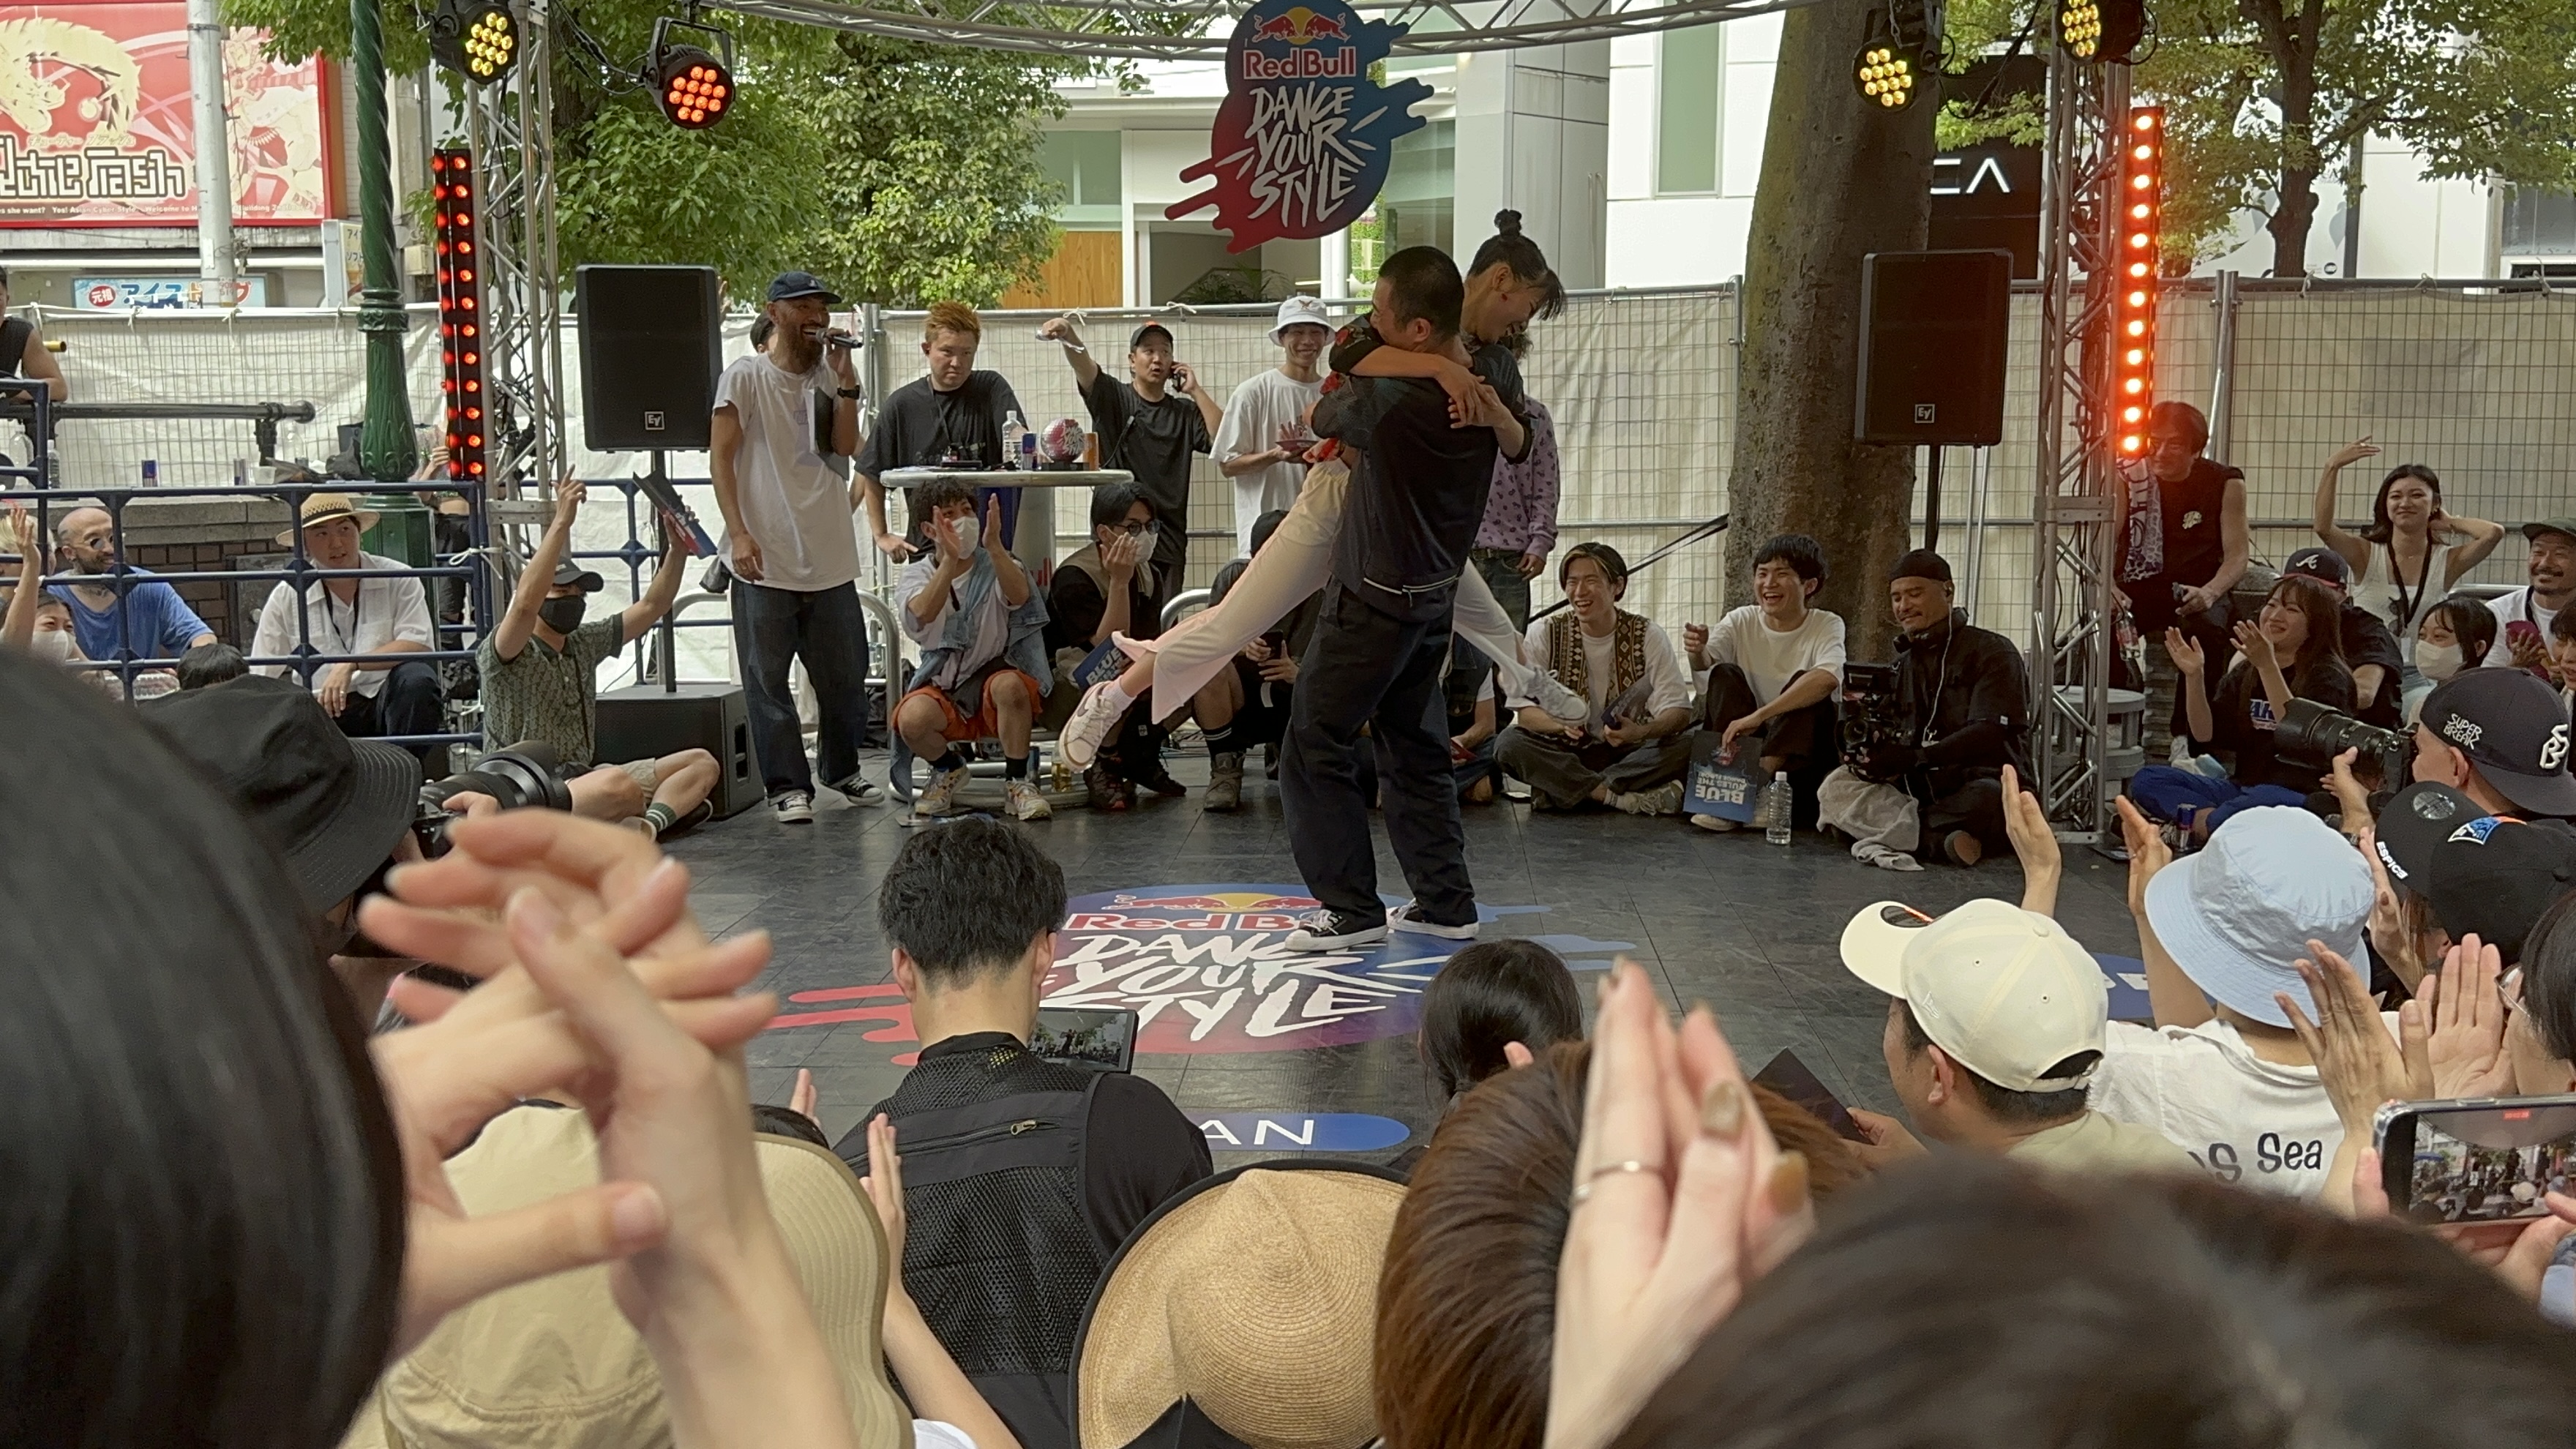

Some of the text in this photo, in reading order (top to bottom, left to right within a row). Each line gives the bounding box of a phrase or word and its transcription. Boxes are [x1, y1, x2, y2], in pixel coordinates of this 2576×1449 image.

[1243, 46, 1356, 80] Red Bull
[1246, 81, 1355, 139] DANCE
[1253, 117, 1366, 177] YOUR
[1247, 151, 1359, 228] STYLE
[91, 290, 114, 304] 元祖
[1086, 647, 1121, 686] BLUE
[2443, 724, 2476, 750] BREAK
[2447, 713, 2482, 741] SUPER
[1695, 785, 1745, 804] BLUE
[1063, 913, 1217, 931] Red
[1038, 955, 1423, 997] YOUR
[2257, 1132, 2323, 1174] Sea
